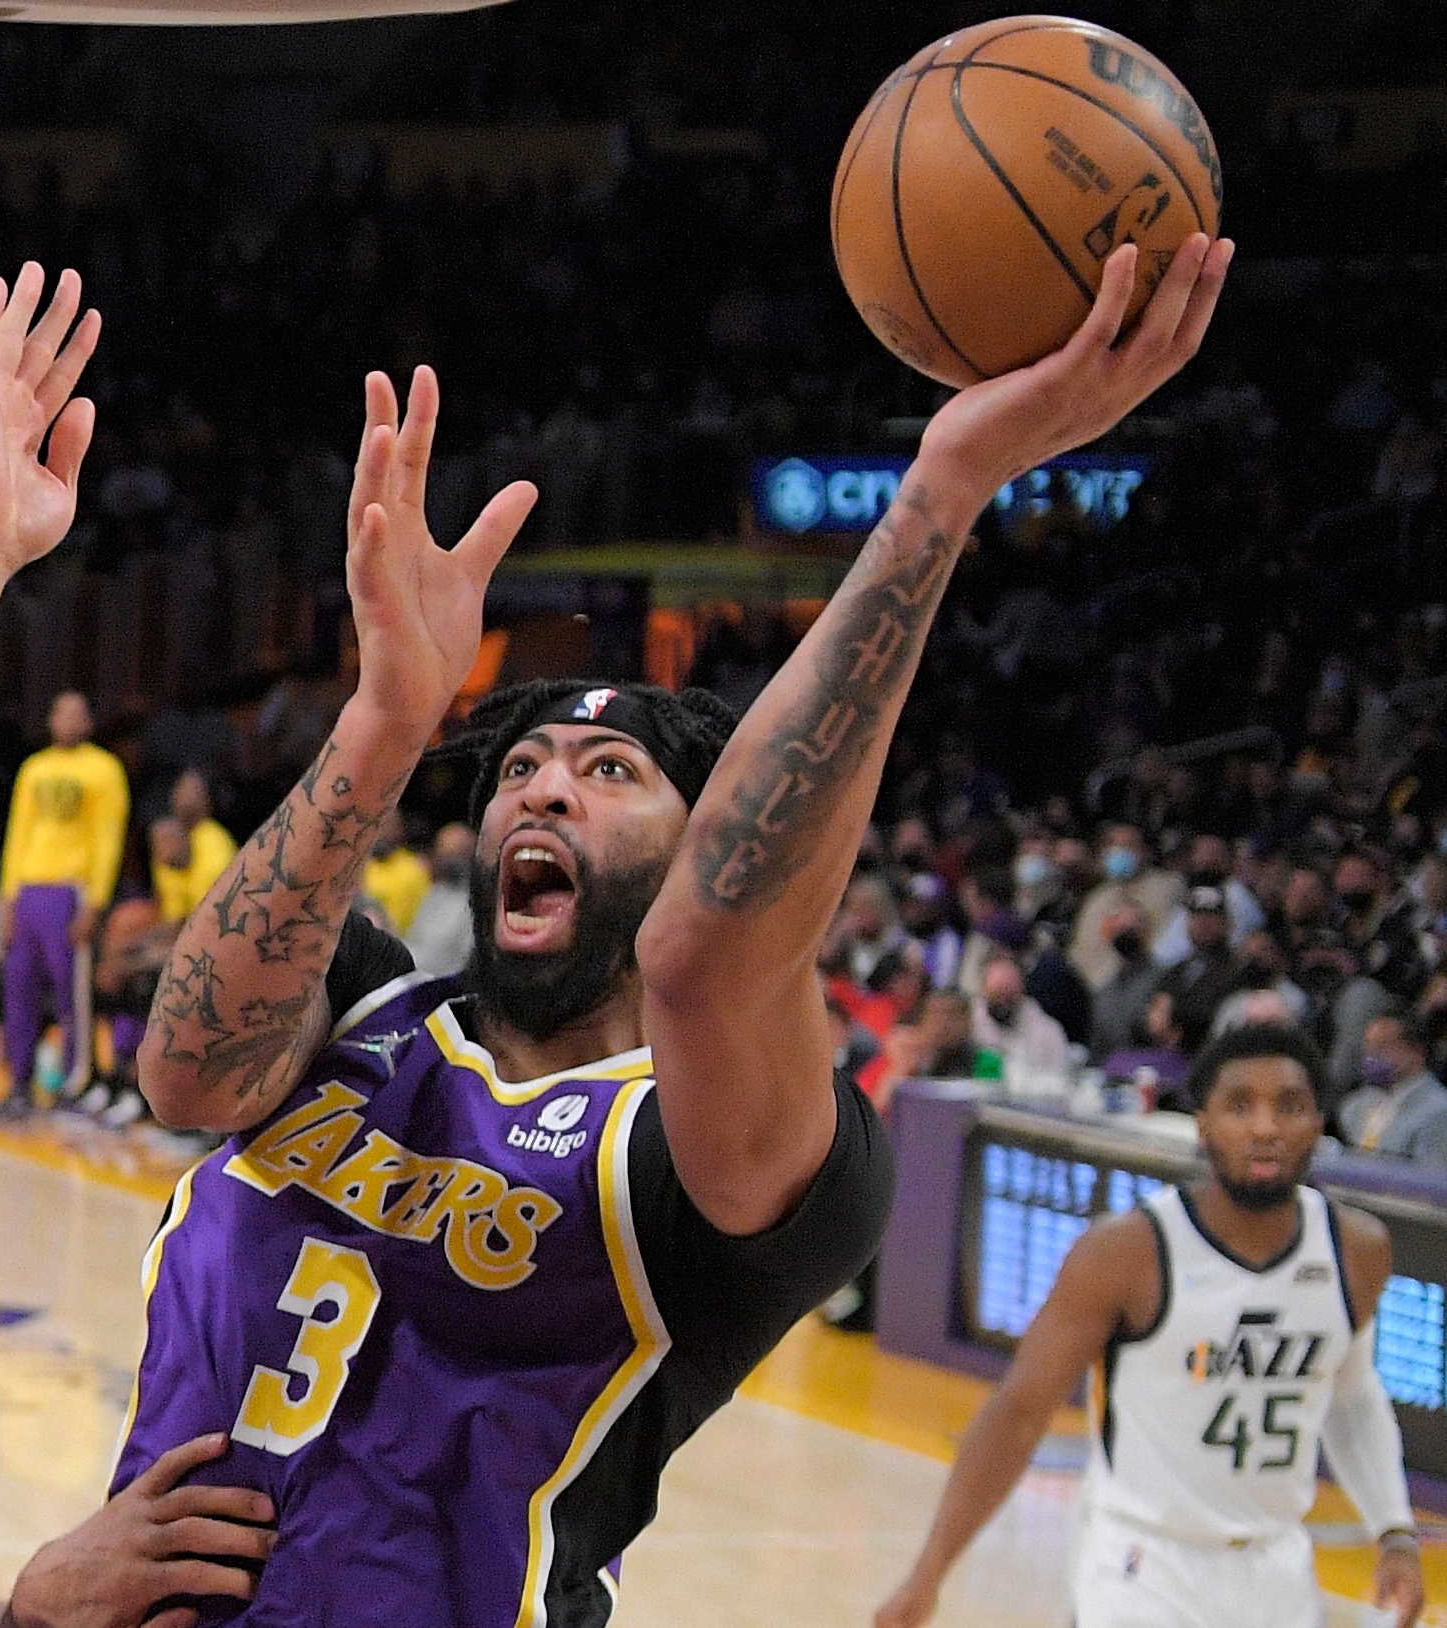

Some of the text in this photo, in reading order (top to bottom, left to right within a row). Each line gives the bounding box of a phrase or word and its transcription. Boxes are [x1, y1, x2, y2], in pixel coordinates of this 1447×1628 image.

[222, 1079, 564, 1291] LAKERS
[506, 1123, 588, 1159] bibigo
[230, 1236, 382, 1457] 3
[1201, 1391, 1305, 1471] 45
